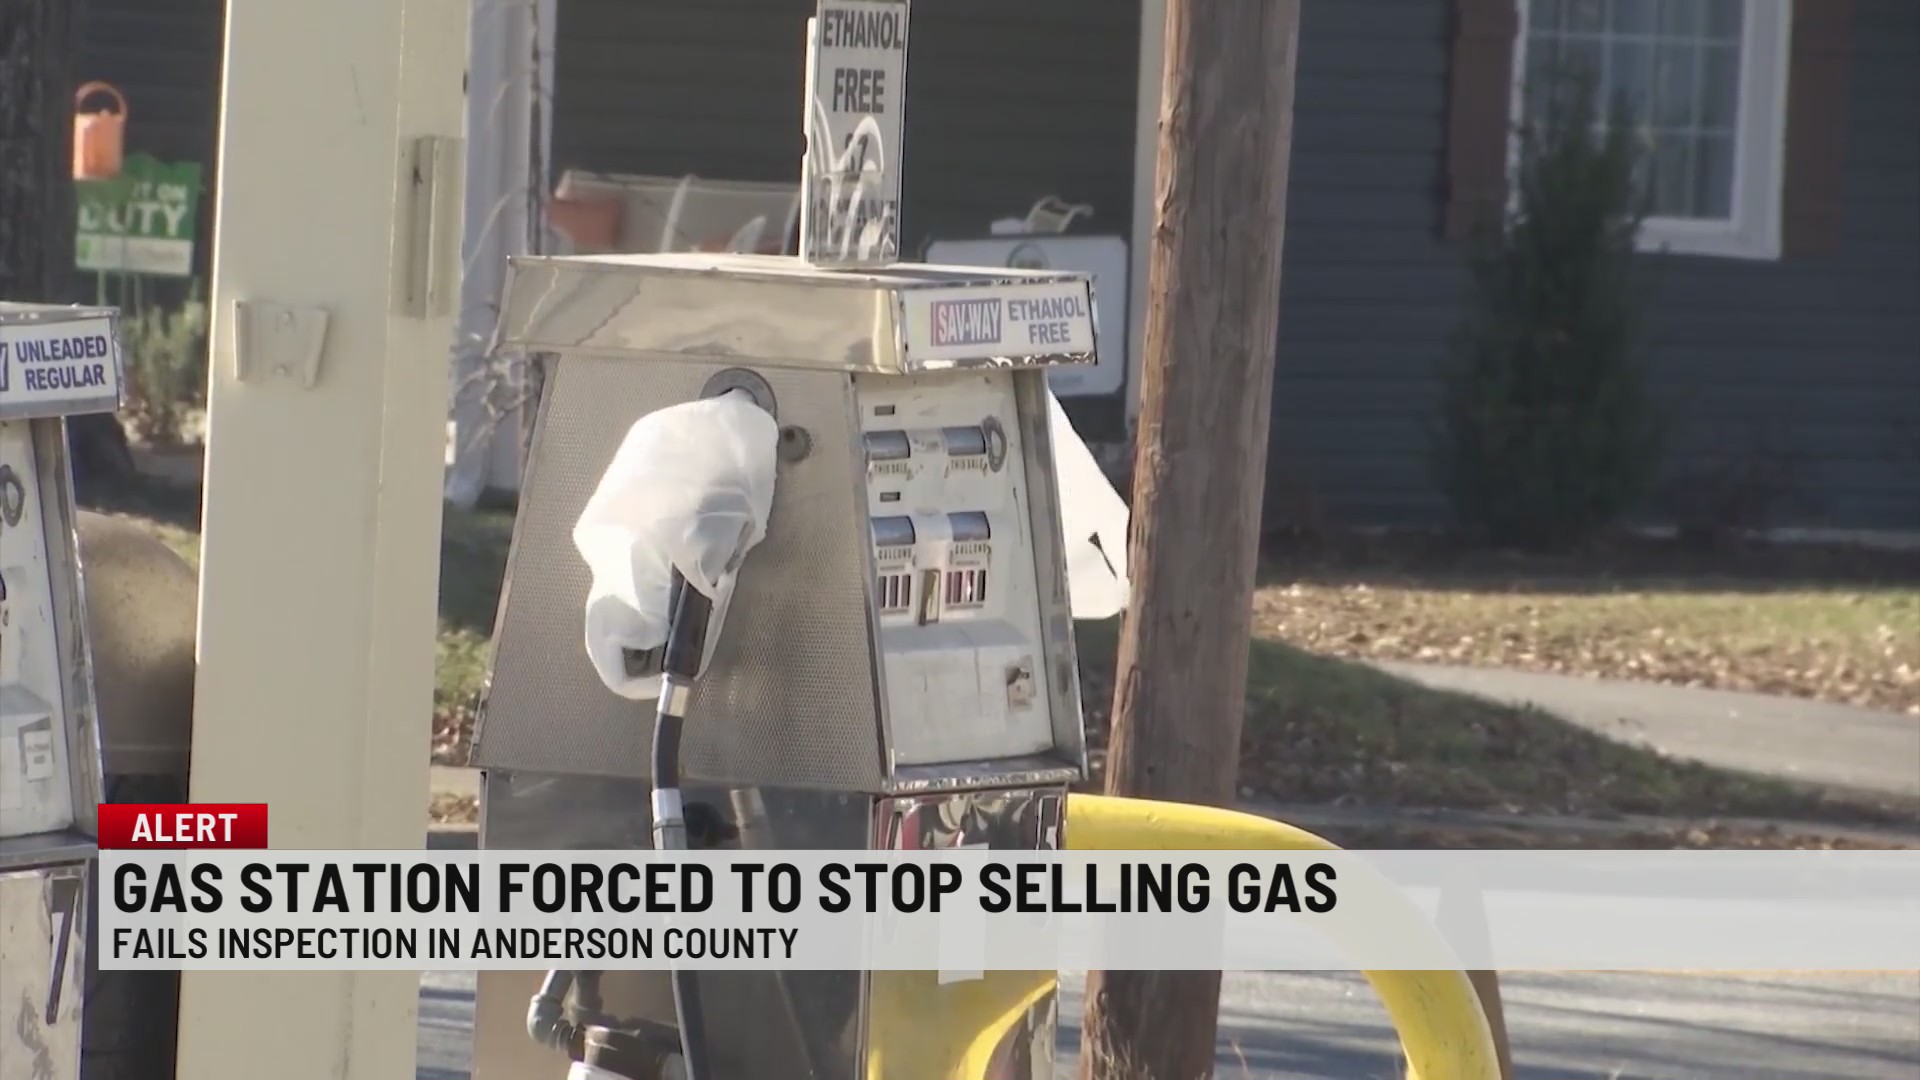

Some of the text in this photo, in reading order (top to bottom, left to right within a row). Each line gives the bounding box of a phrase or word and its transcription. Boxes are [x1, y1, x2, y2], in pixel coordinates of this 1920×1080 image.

[822, 9, 903, 50] ETHANOL
[832, 67, 886, 114] FREE
[79, 201, 188, 237] DUTY
[1007, 296, 1086, 321] ETHANOL
[1028, 322, 1071, 345] FREE
[15, 335, 108, 364] UNLEADED
[24, 363, 107, 391] REGULAR
